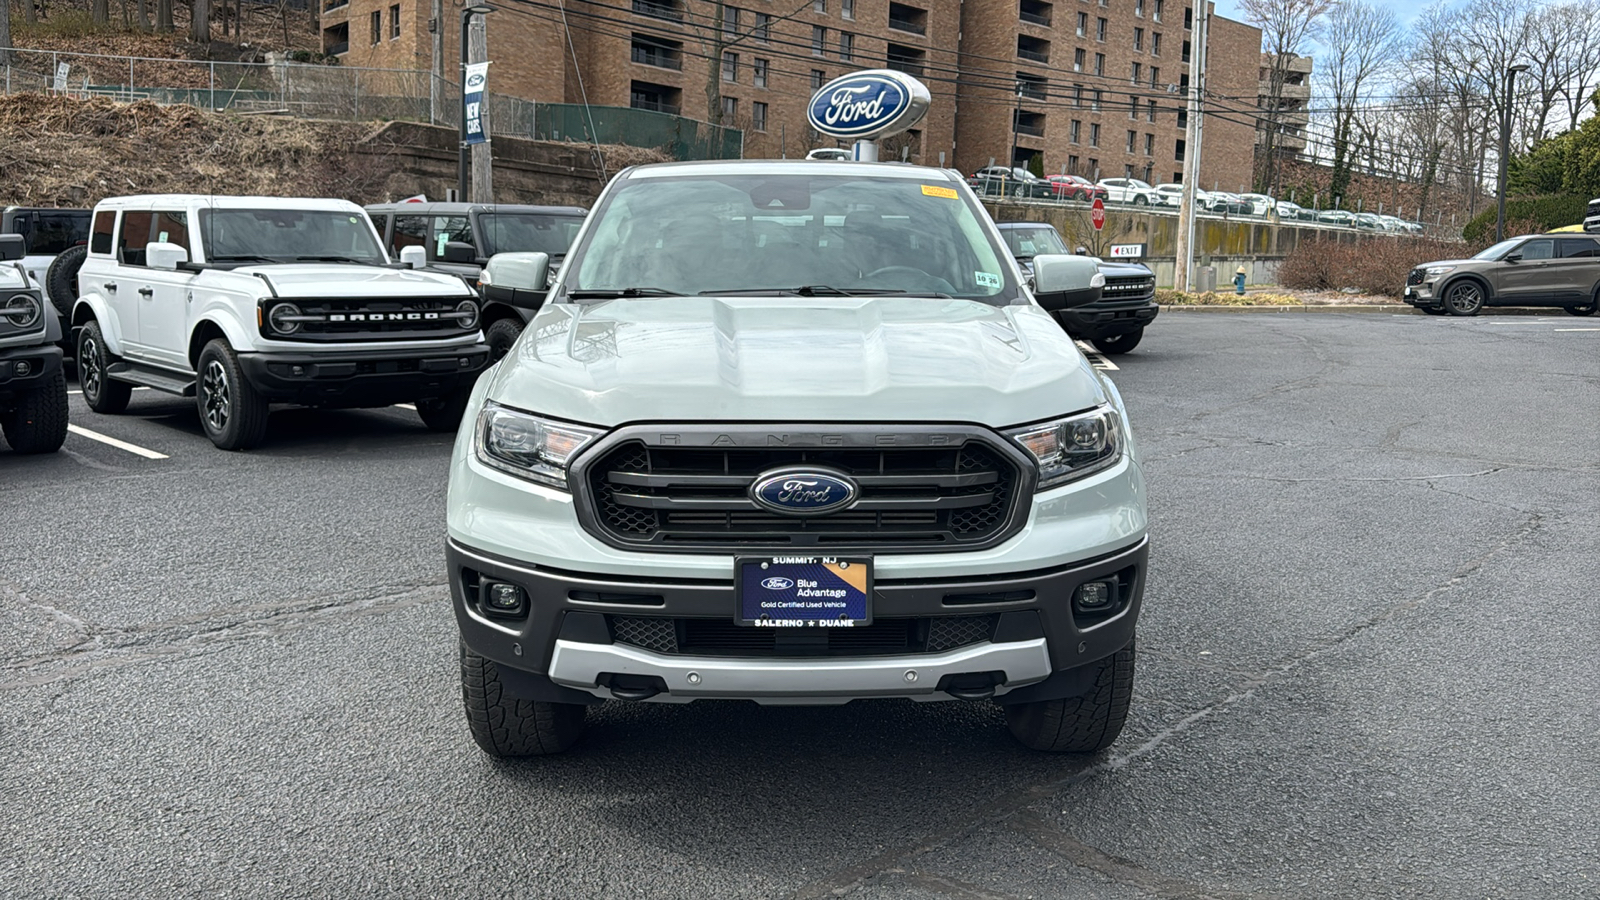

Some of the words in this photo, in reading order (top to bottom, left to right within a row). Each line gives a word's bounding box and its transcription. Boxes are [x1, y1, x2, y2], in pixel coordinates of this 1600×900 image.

[825, 84, 887, 125] Ford
[466, 102, 480, 120] NEW
[467, 119, 481, 134] CARS
[1092, 208, 1105, 221] STOP
[1121, 246, 1139, 256] EXIT
[330, 313, 438, 321] BRONCO
[660, 433, 950, 445] RANGER
[778, 480, 832, 502] Ford
[767, 579, 788, 588] Ford
[797, 579, 818, 588] Blue
[797, 588, 847, 598] Advantage
[754, 619, 803, 627] SALERNO
[819, 619, 854, 627] DUANE
